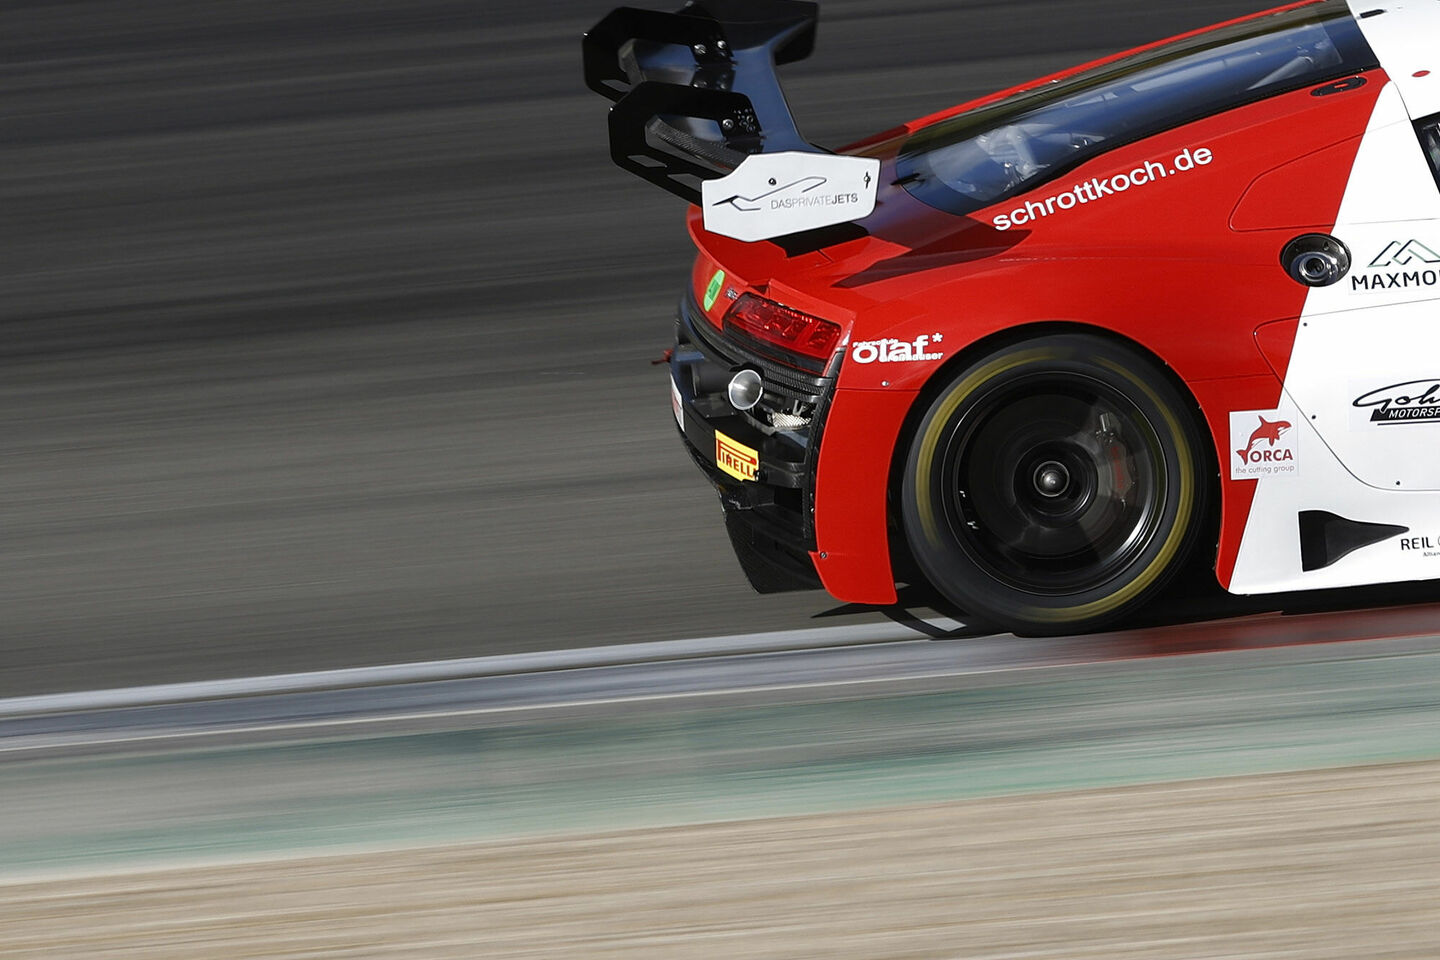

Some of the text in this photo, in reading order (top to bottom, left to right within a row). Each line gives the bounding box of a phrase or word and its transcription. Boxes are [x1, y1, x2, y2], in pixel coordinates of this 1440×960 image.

[992, 146, 1213, 231] schrottkoch.de
[770, 193, 859, 210] DASPRIVATEJETS
[1249, 448, 1294, 463] ORCA
[1248, 466, 1272, 474] cutting
[1273, 465, 1295, 473] group
[1400, 536, 1434, 551] REIL
